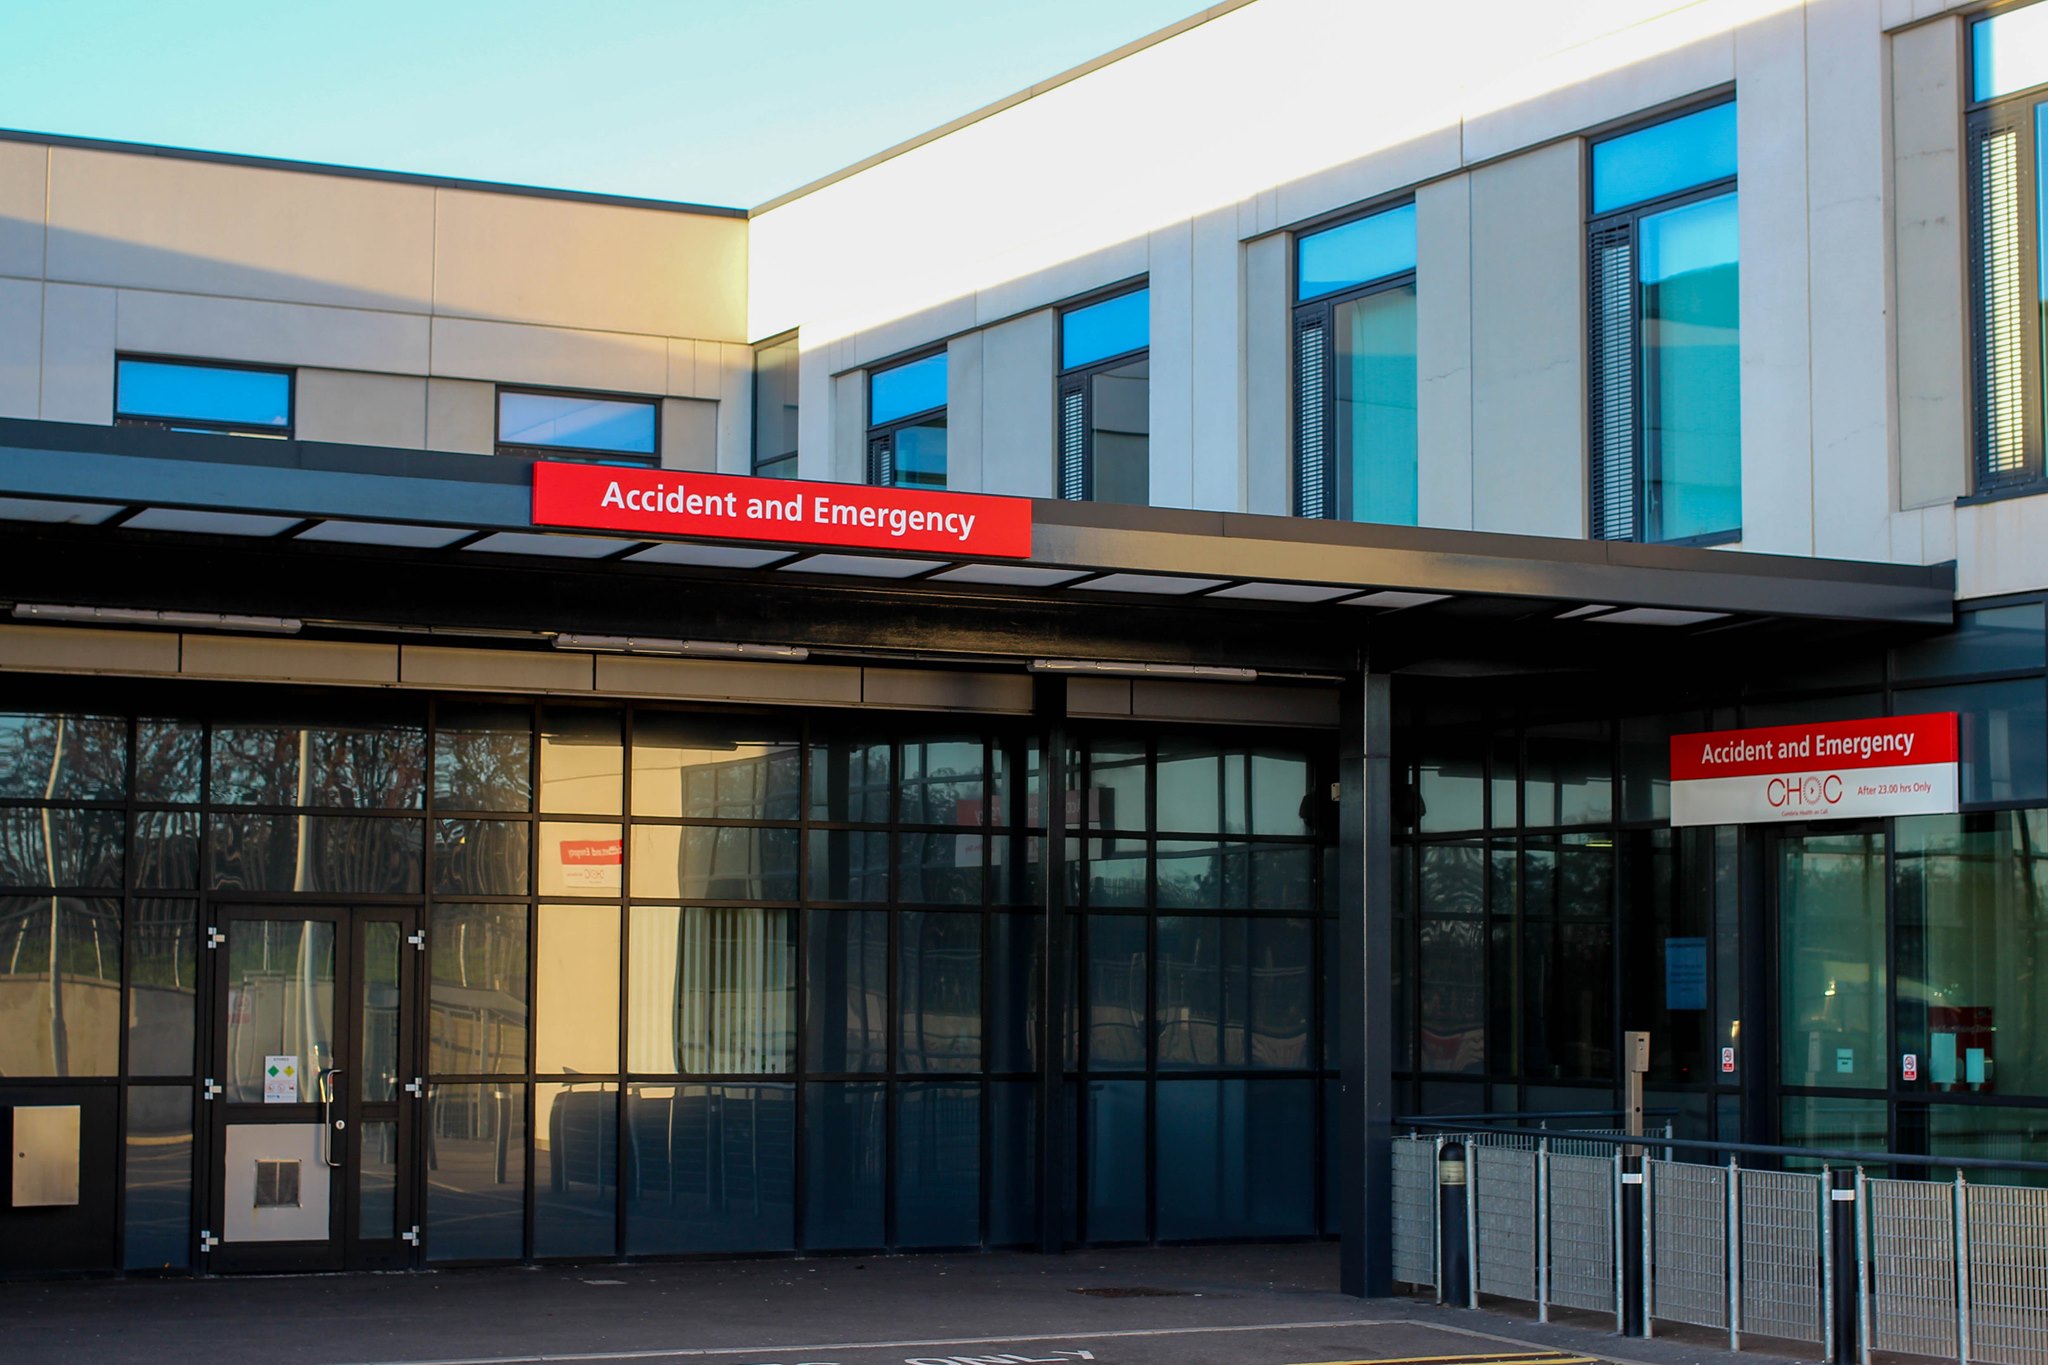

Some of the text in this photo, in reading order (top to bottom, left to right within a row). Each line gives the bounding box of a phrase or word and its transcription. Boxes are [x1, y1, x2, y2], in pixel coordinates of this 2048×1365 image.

[600, 480, 976, 541] Accident and Emergency
[1701, 732, 1915, 765] Accident and Emergency
[1767, 774, 1843, 807] CHOC
[1857, 781, 1931, 796] After 23.00 hrs Only
